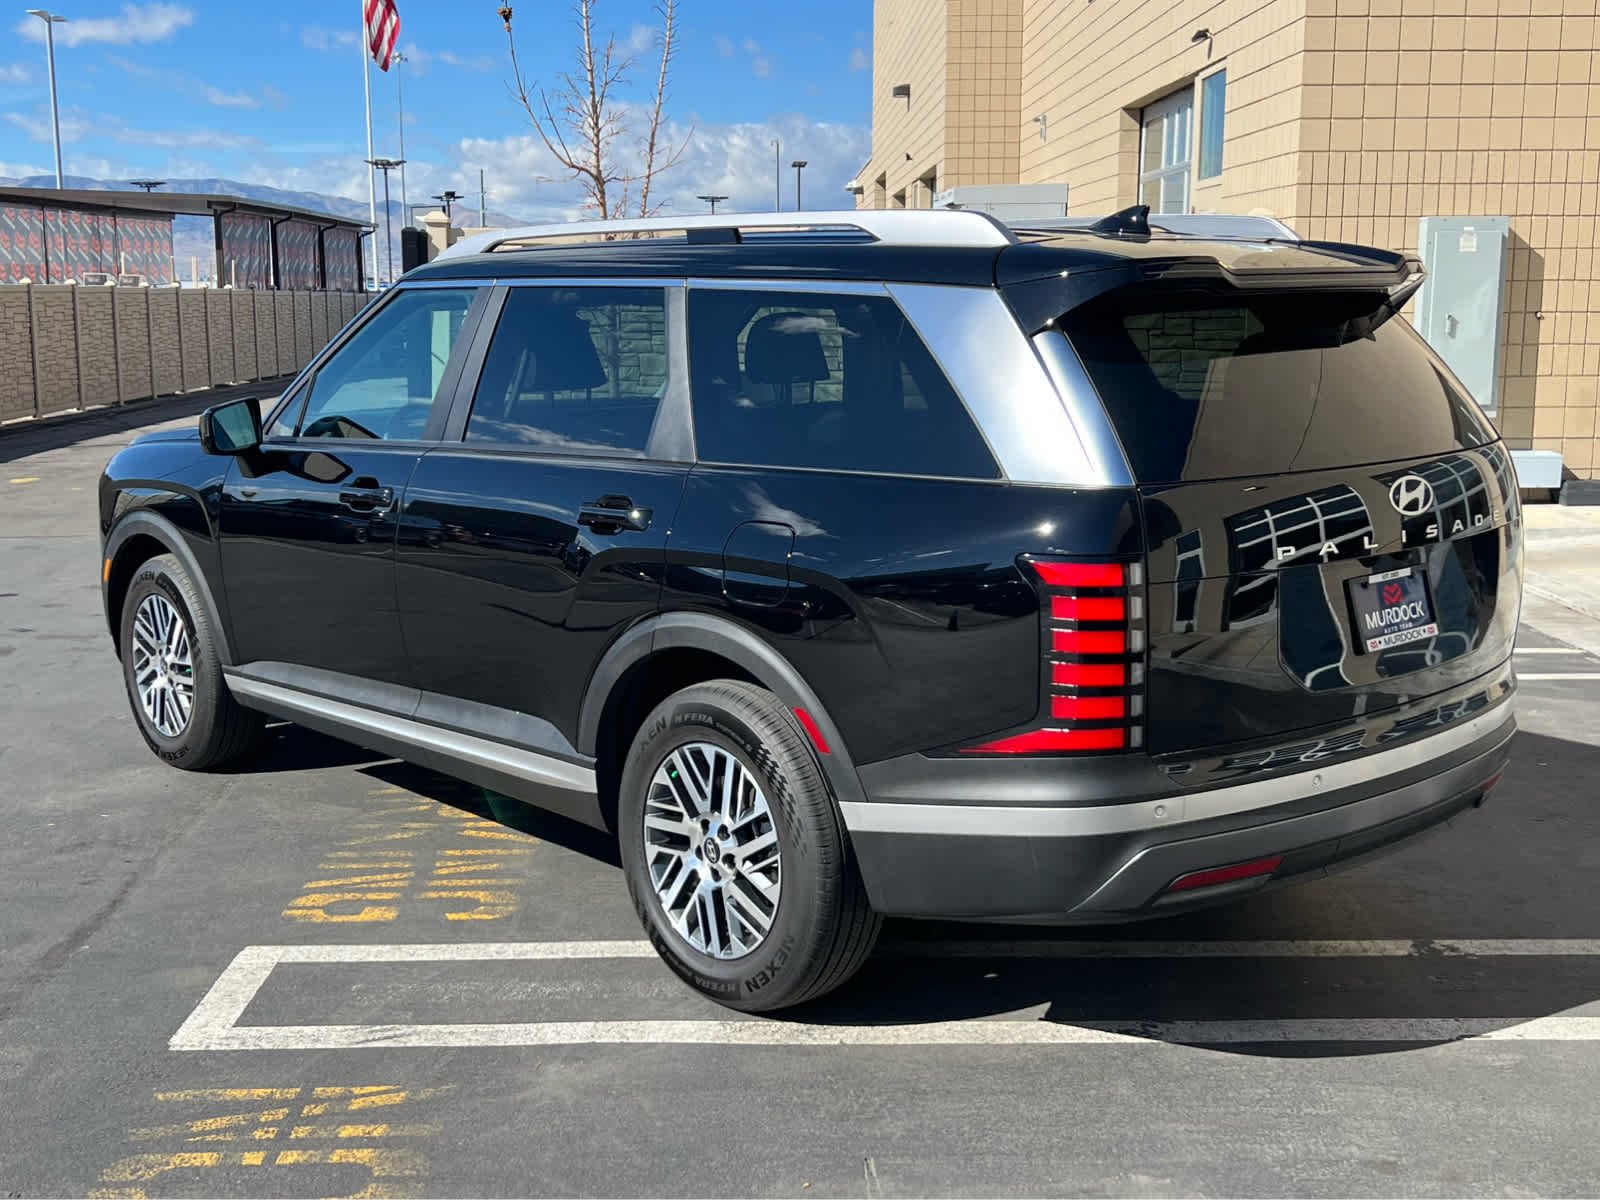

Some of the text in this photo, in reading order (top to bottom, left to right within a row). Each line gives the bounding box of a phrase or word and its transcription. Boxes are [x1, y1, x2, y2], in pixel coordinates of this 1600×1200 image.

[1276, 510, 1501, 560] PALISADE
[1364, 600, 1425, 630] MURDOCK
[1383, 630, 1424, 645] MURDOCK
